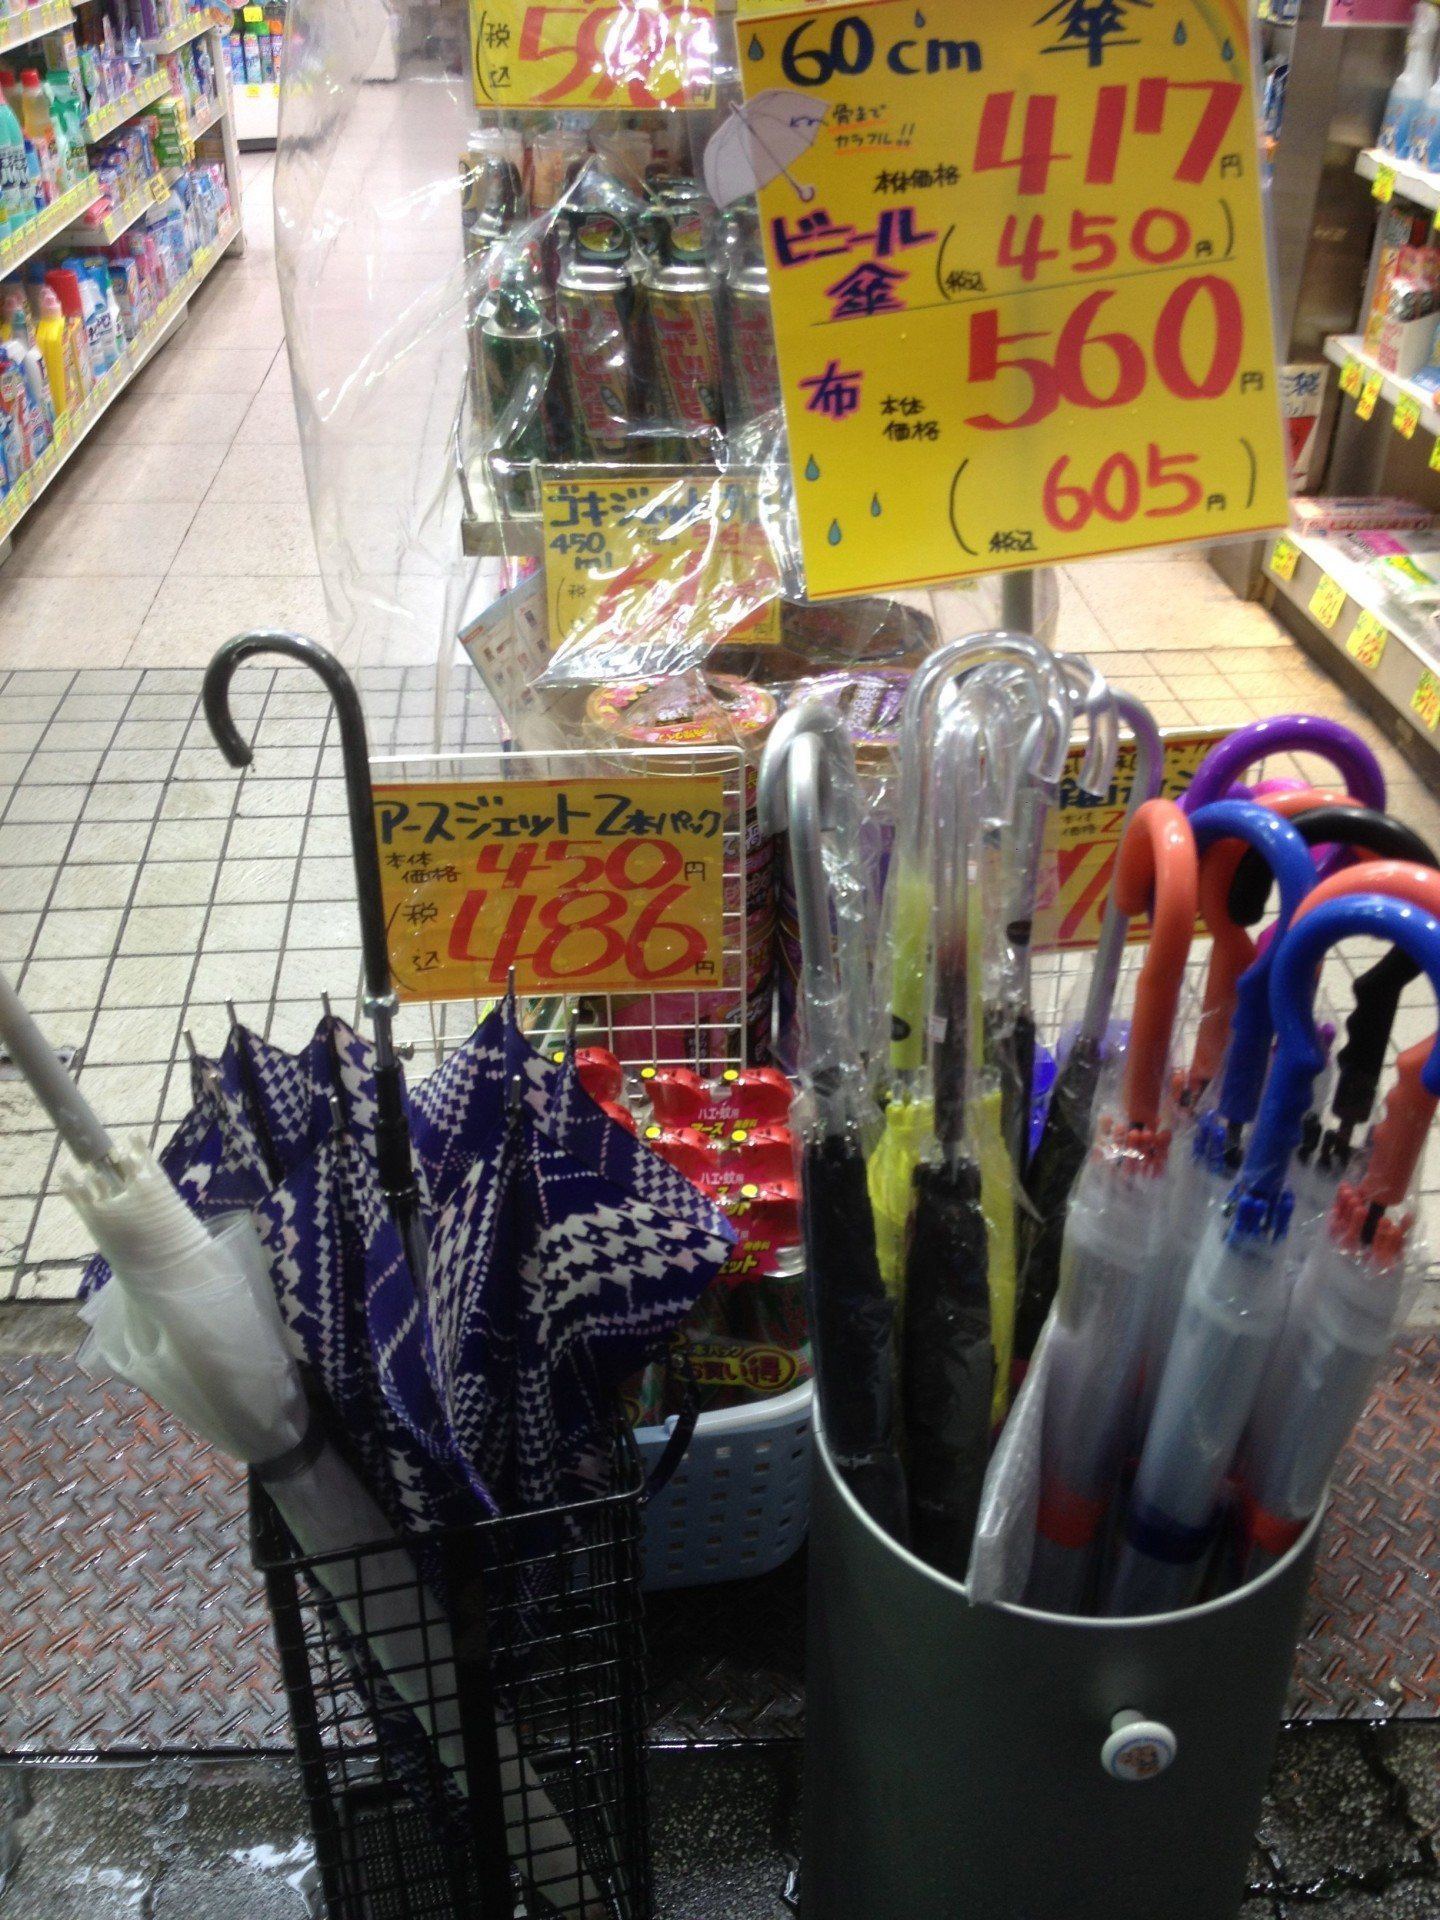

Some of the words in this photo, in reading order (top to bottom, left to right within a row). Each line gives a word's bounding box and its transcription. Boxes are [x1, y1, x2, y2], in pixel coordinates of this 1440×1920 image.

[1033, 0, 1154, 67] 傘
[873, 163, 960, 194] 本体価格
[769, 206, 937, 268] ビニール
[826, 261, 910, 323] 傘
[799, 360, 863, 420] 布
